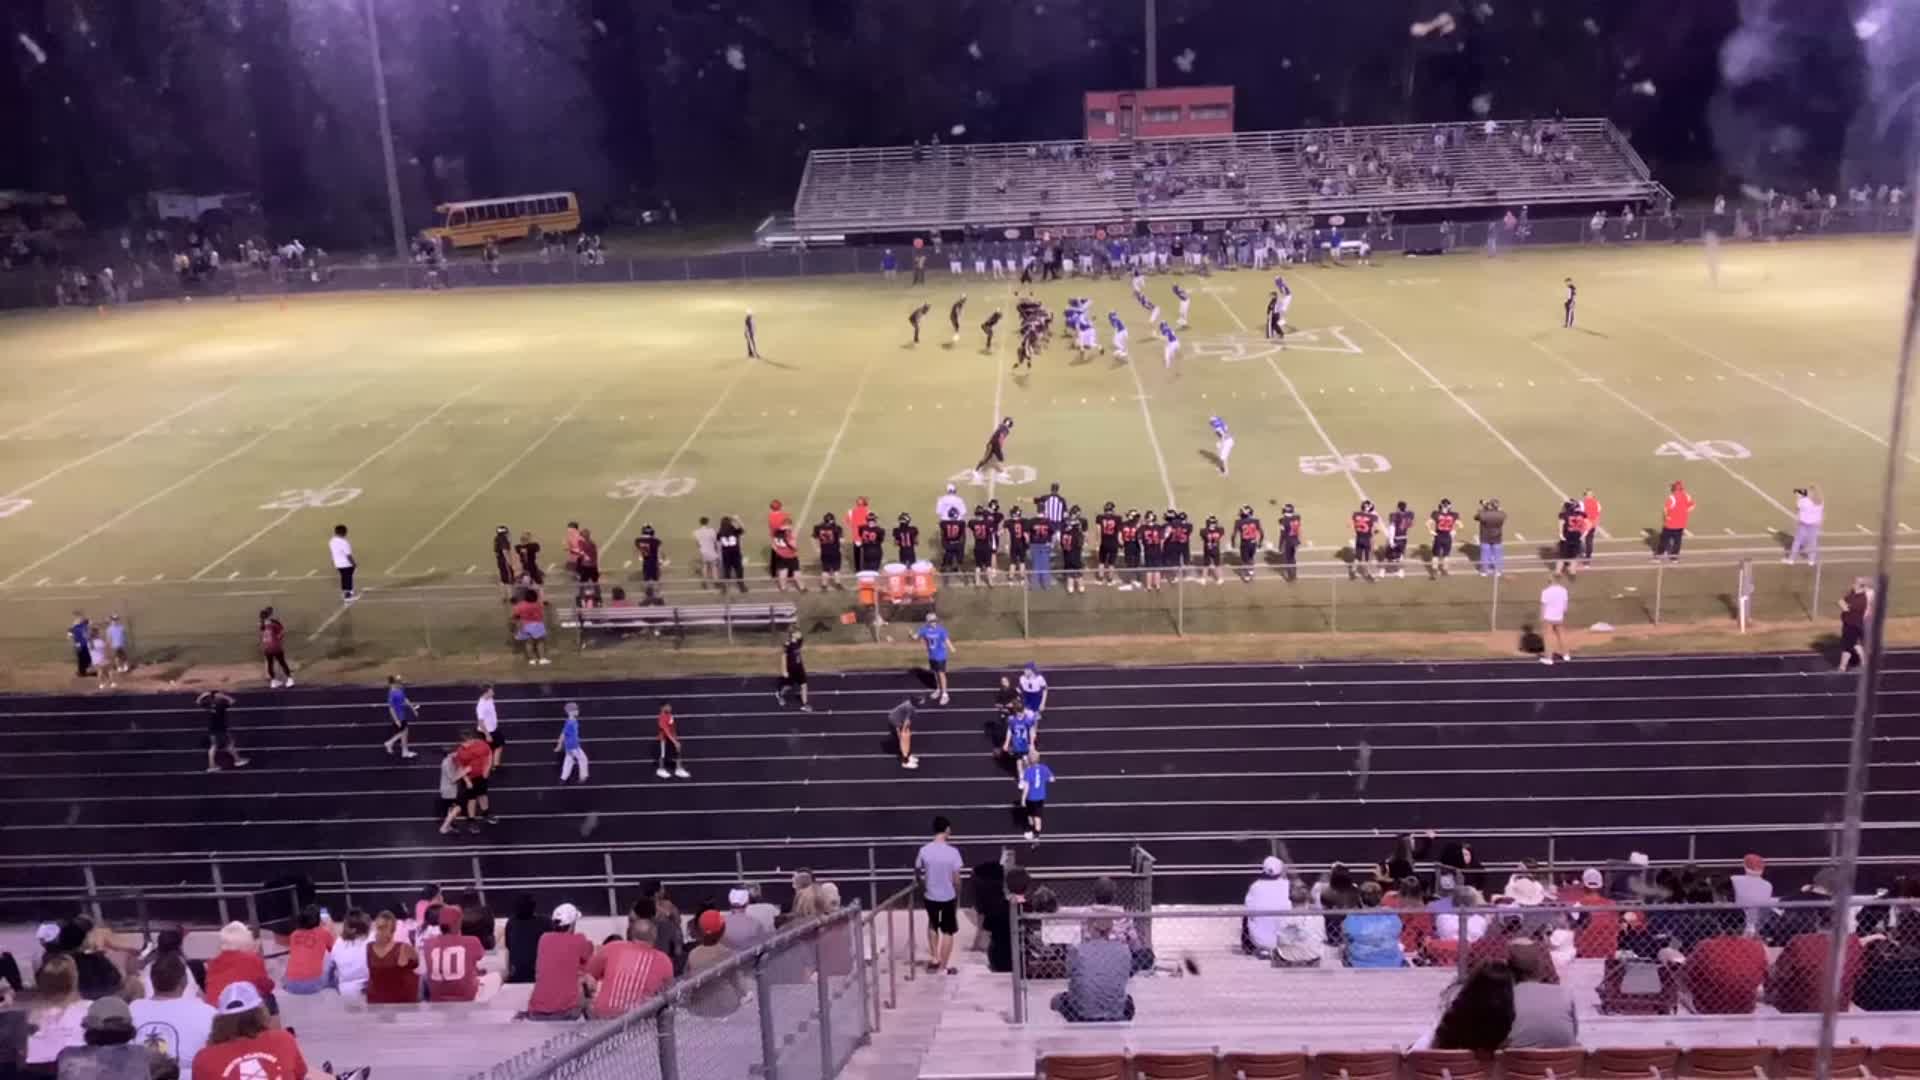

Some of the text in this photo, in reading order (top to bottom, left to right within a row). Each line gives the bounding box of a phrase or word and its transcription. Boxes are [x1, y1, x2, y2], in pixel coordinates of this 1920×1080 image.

[1655, 440, 1753, 462] 40
[1299, 453, 1393, 475] 50
[257, 487, 364, 511] 20
[606, 476, 698, 500] 30
[431, 945, 466, 981] 10
